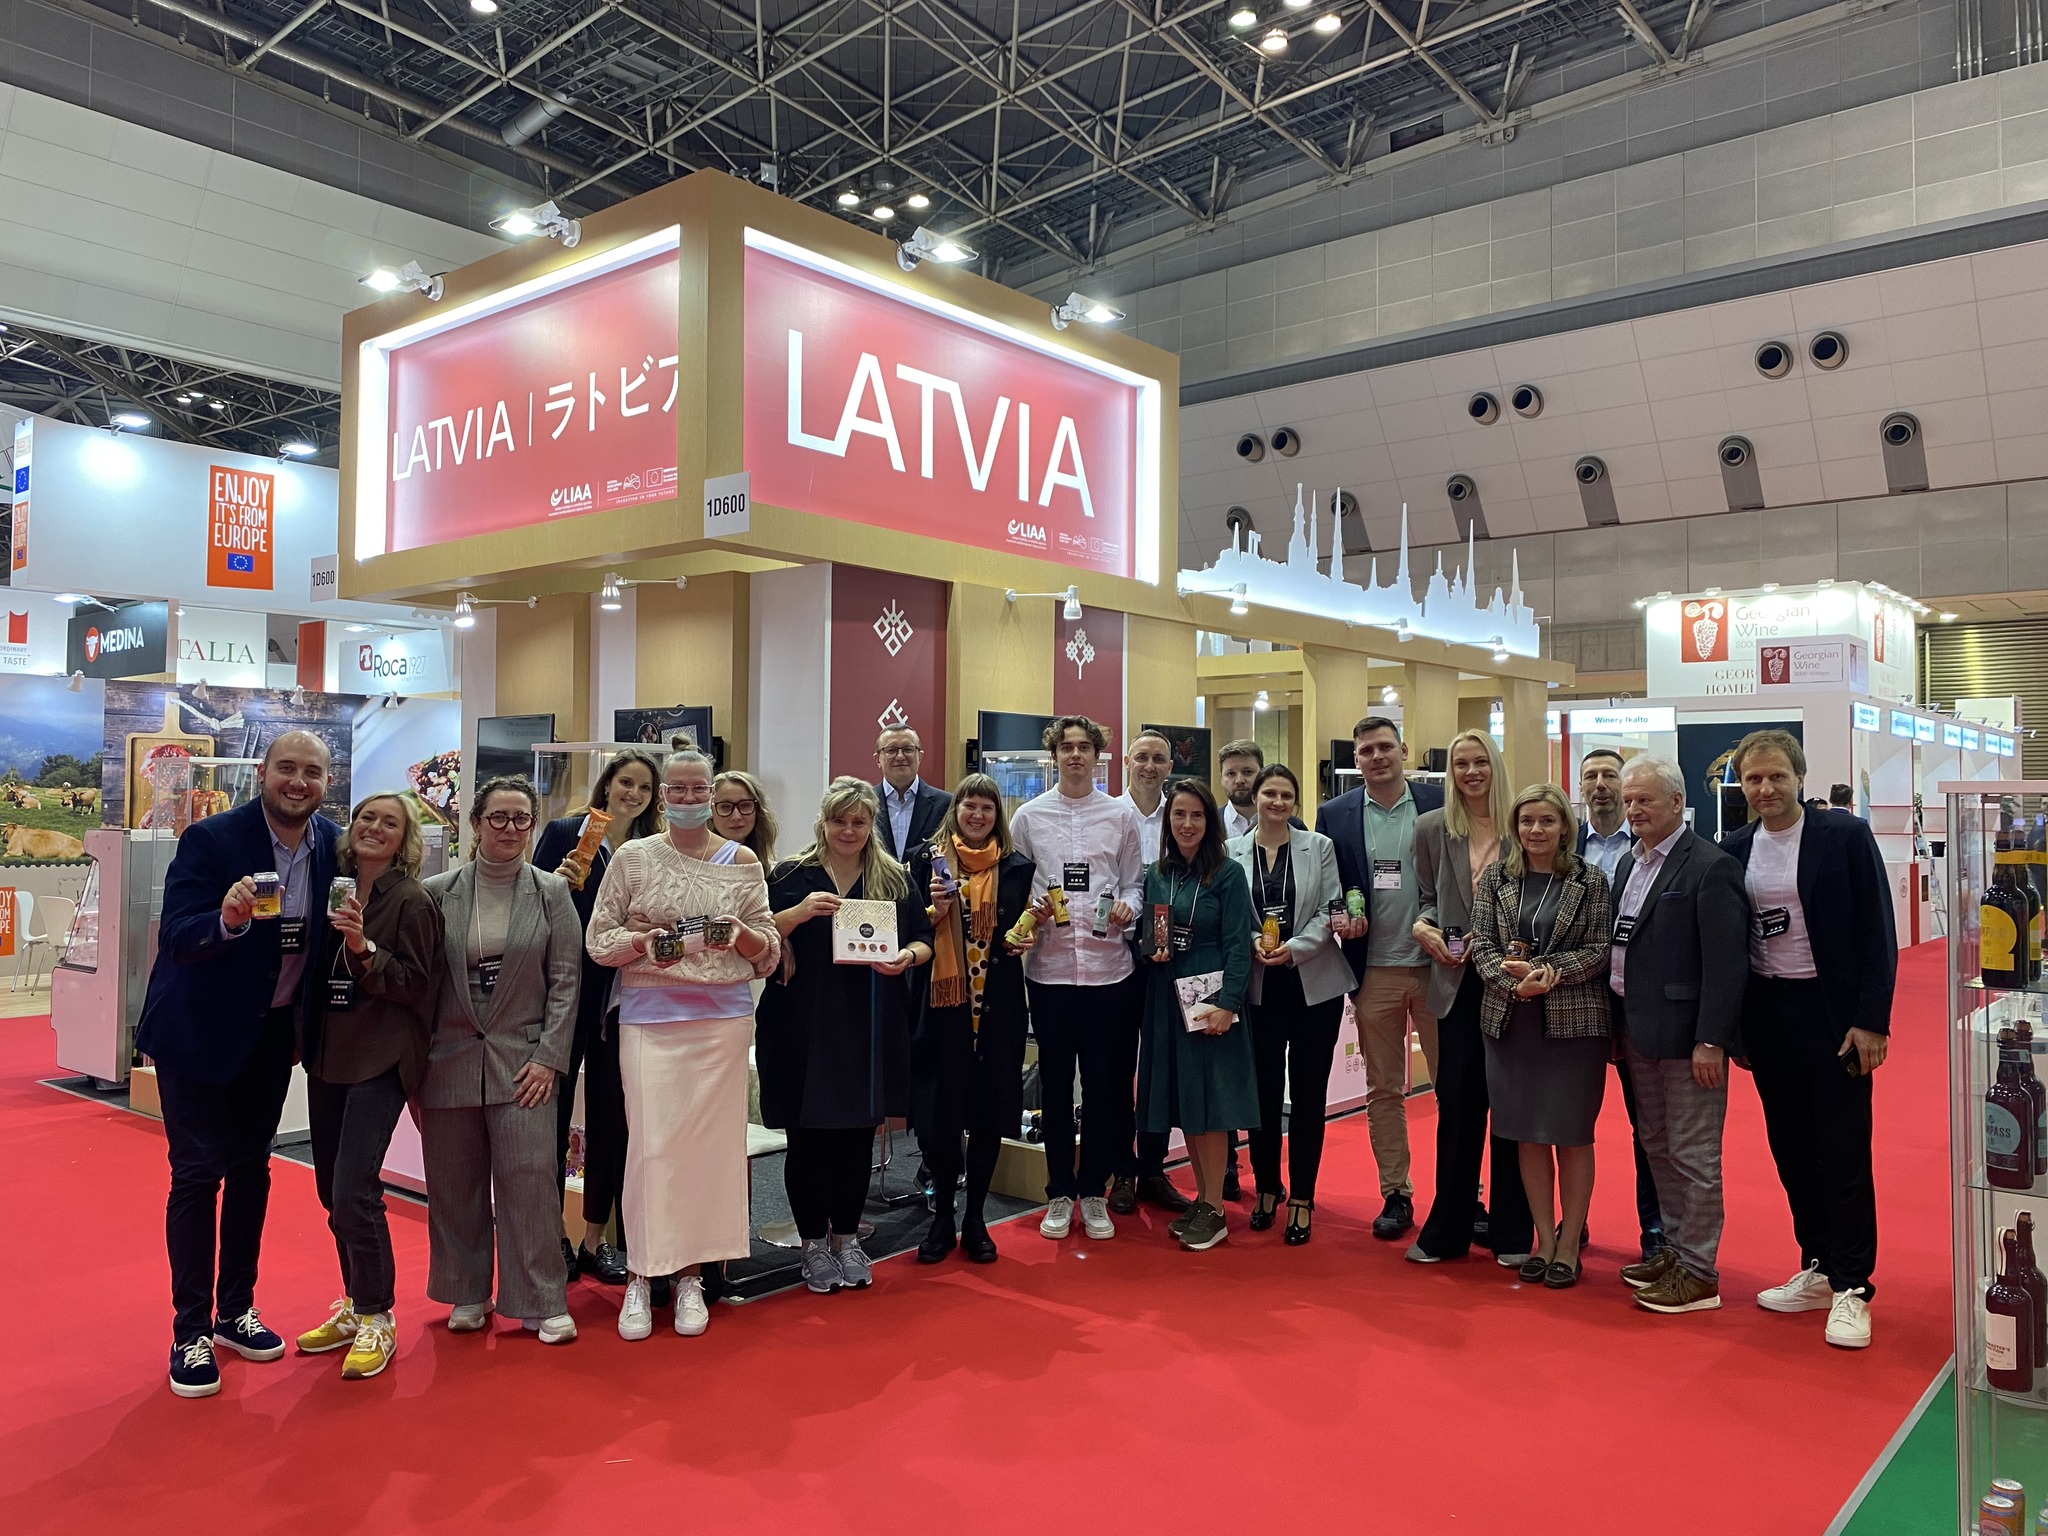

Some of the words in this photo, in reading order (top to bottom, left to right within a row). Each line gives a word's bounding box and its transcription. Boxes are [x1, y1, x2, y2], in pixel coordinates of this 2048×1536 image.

[787, 328, 1095, 518] LATVIA
[392, 399, 515, 482] LATVIA
[214, 472, 270, 508] ENJOY
[563, 483, 592, 504] LIAA
[215, 502, 237, 524] IT'S
[239, 505, 267, 528] FROM
[706, 492, 746, 518] 1D600
[214, 523, 267, 552] EUROPE
[1020, 522, 1047, 542] LIAA
[312, 570, 335, 587] 1D600
[100, 626, 145, 654] MEDINA
[1735, 623, 1779, 637] Wine
[3, 657, 27, 666] TASTE
[373, 654, 407, 678] Roca
[1793, 650, 1839, 661] Georgian
[1793, 661, 1821, 670] Wine
[1715, 668, 1756, 680] GEOR
[1594, 716, 1623, 725] Winery
